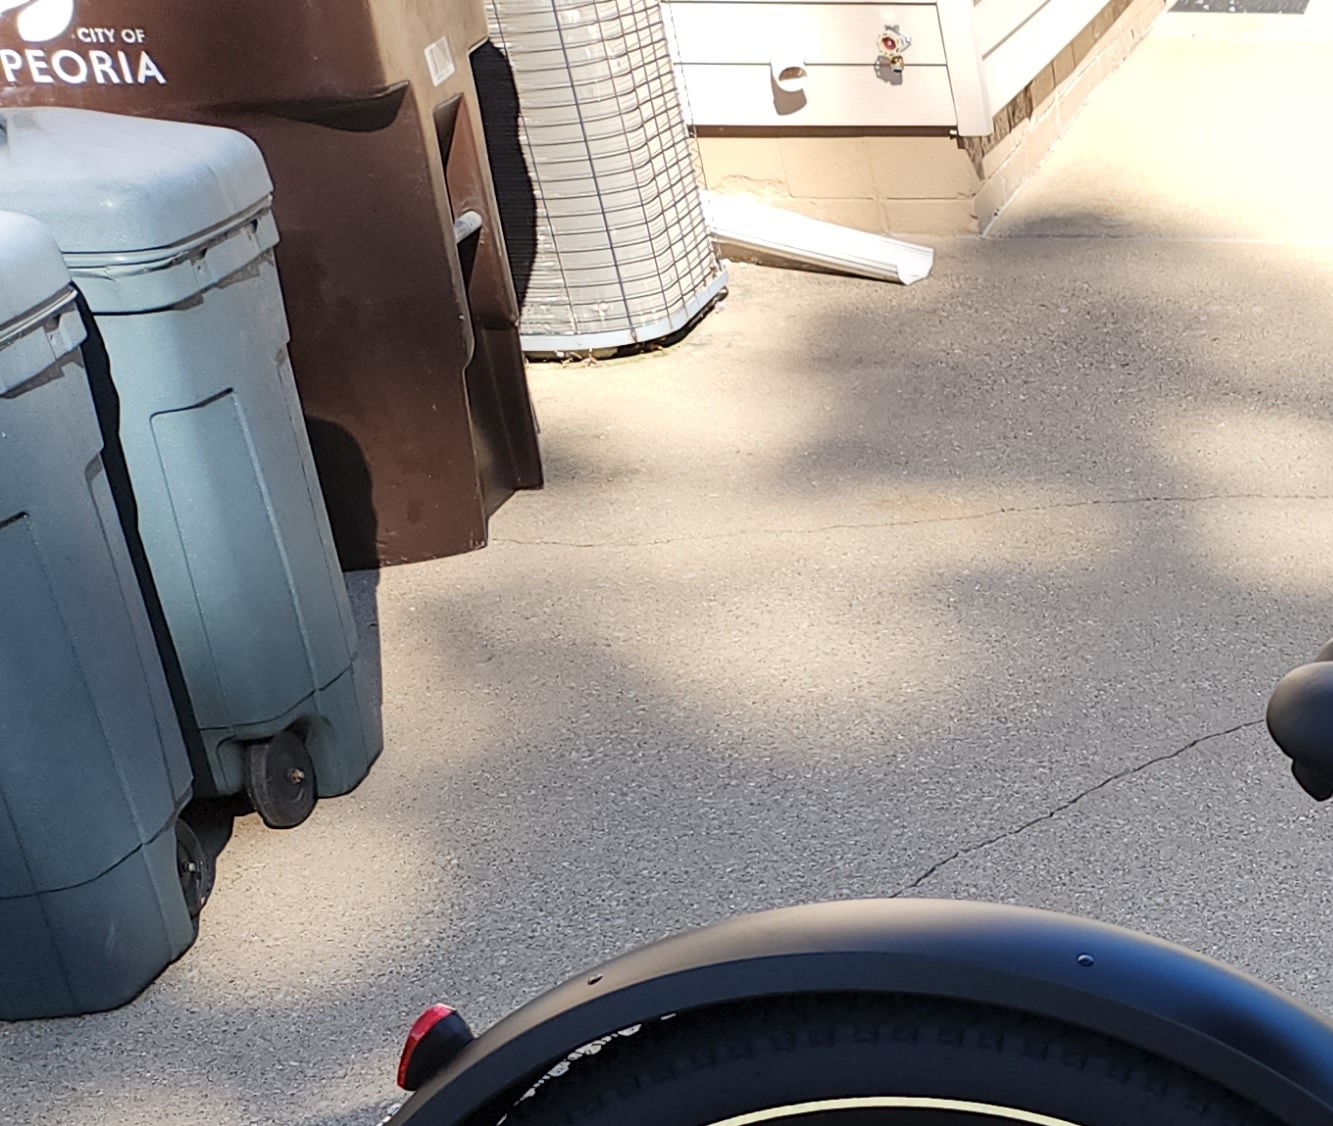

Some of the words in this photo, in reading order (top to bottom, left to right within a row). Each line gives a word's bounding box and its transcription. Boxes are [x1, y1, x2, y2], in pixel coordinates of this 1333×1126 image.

[77, 27, 115, 43] CITY
[121, 29, 145, 43] OF
[0, 49, 167, 84] PEORIA
